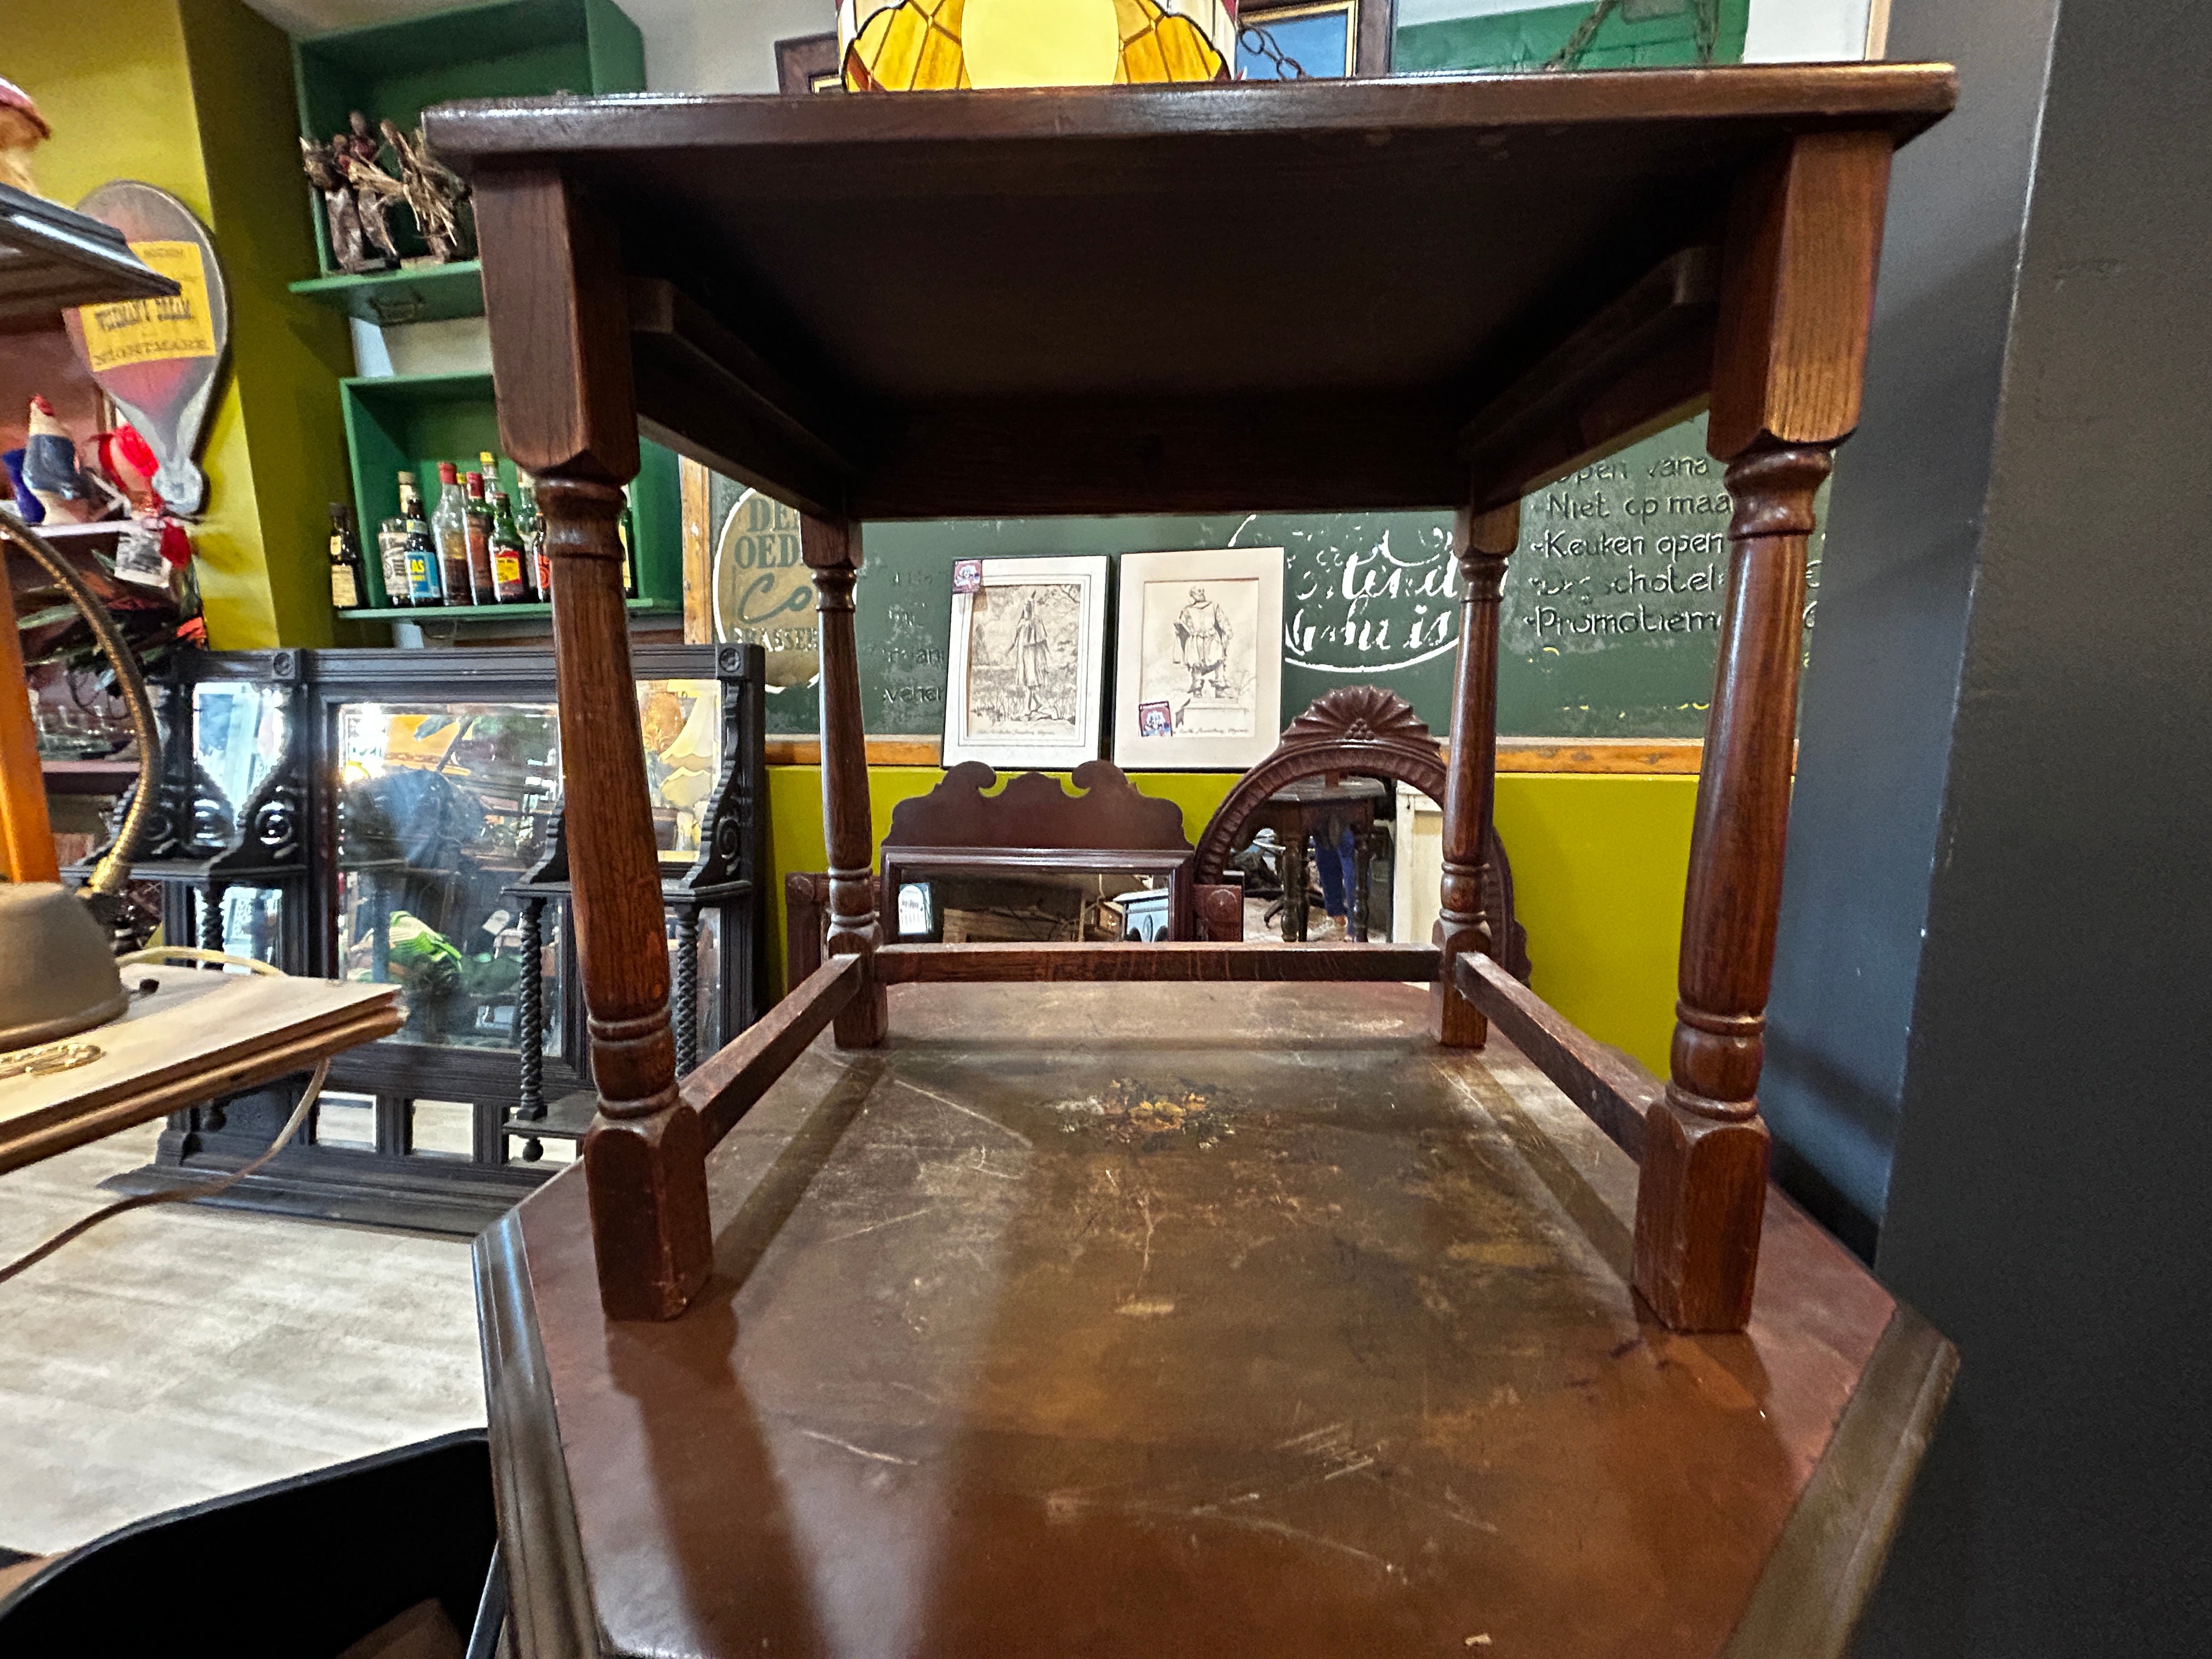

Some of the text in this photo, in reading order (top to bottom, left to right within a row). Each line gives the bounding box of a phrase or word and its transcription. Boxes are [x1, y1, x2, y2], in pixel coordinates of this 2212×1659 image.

[1556, 461, 1628, 486] pen
[1547, 491, 1611, 520] Niet
[1543, 529, 1723, 563] Keuken open
[1535, 604, 1723, 637] Promotiem
